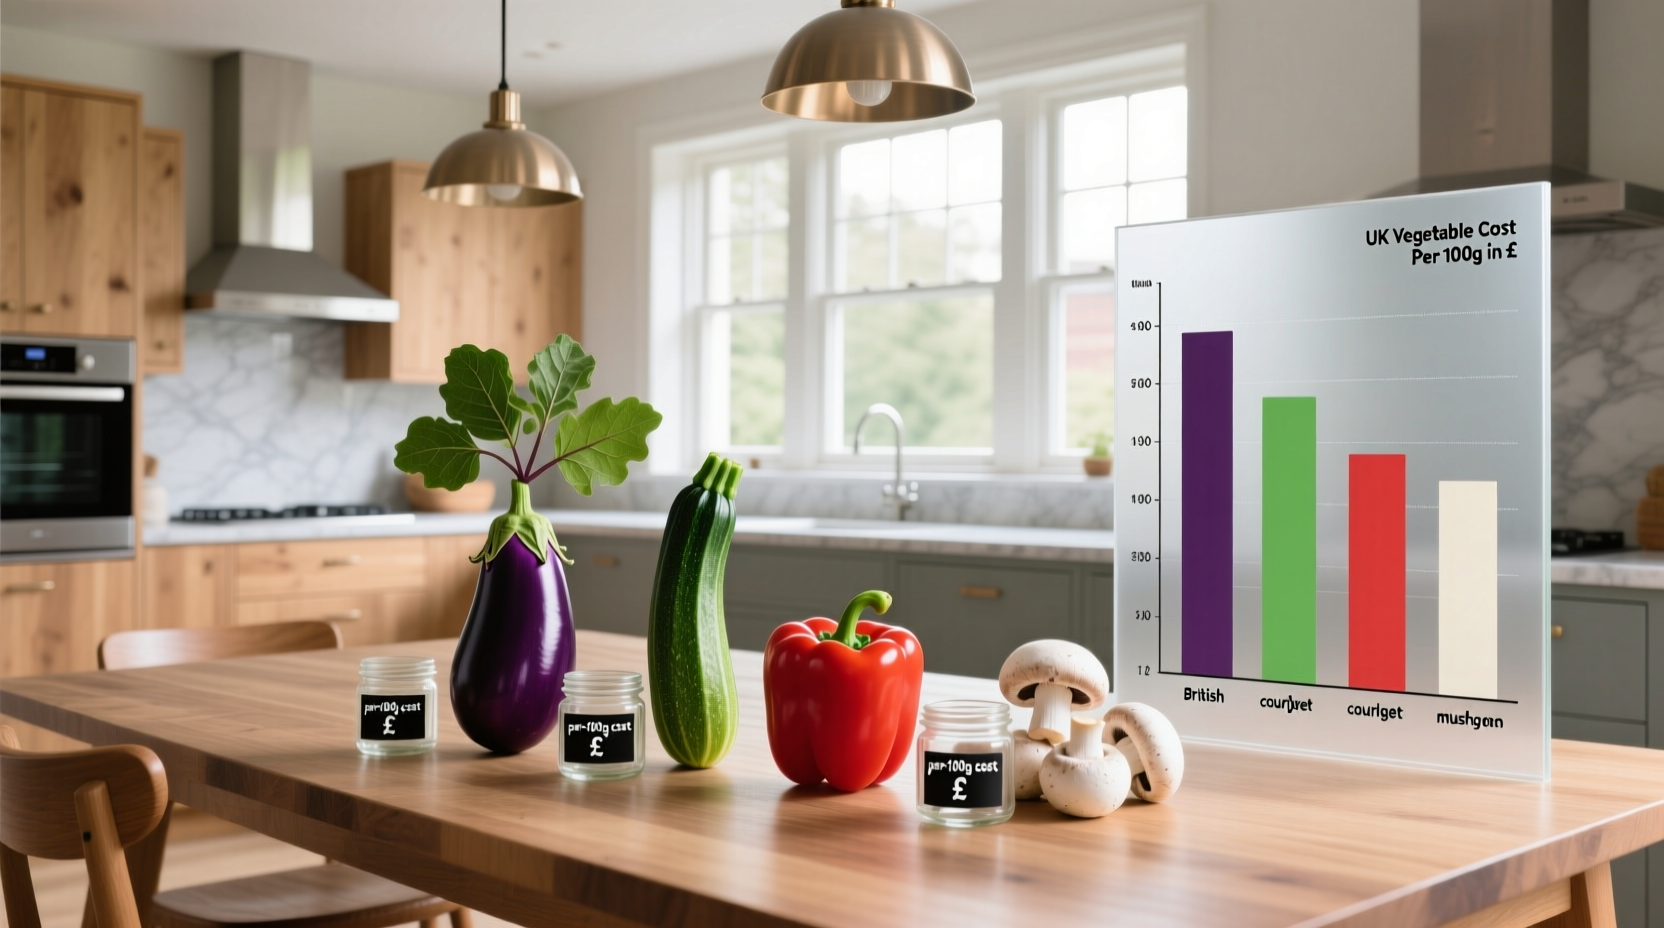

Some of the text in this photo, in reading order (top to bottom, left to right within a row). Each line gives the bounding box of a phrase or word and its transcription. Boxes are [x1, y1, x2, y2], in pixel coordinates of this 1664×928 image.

[1366, 220, 1517, 247] UK Vegetable Cost
[1412, 241, 1518, 265] Per 100g in £
[382, 715, 396, 735] £
[589, 736, 604, 757] £
[952, 776, 967, 801] £
